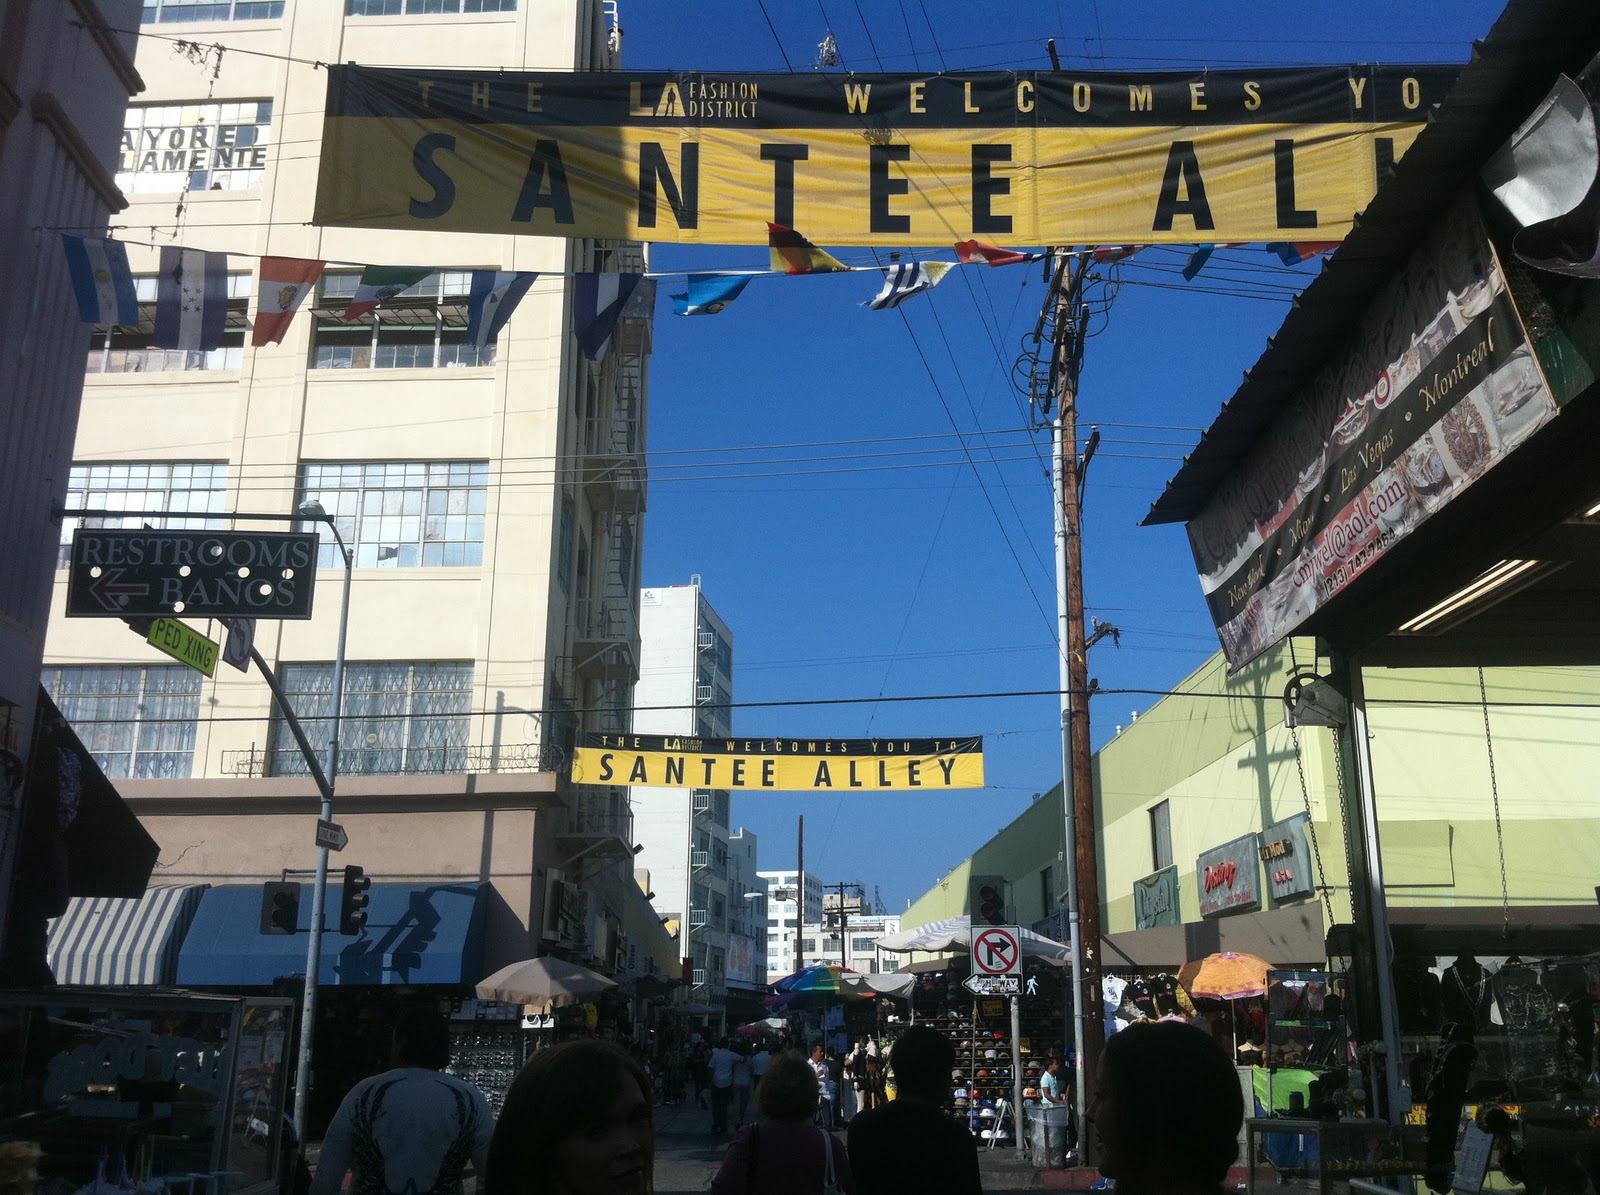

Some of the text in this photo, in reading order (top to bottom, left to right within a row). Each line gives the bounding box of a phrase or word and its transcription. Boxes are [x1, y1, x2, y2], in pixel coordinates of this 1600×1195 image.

[418, 81, 543, 113] THE
[630, 82, 685, 117] LA
[844, 81, 1261, 114] WELCOMES
[689, 82, 759, 100] FASHION
[689, 101, 758, 119] DISTRICT
[409, 133, 1013, 233] SANTEE
[1341, 461, 1357, 494] Las
[1357, 428, 1394, 473] Vegas
[1418, 317, 1495, 411] Montreal
[79, 536, 310, 568] RESTROOMS
[159, 570, 296, 607] BAÑOS
[154, 618, 213, 668] PED XING
[602, 735, 957, 753] THE LA WELCOMES YOU TO
[599, 753, 956, 787] SANTEE ALLEY
